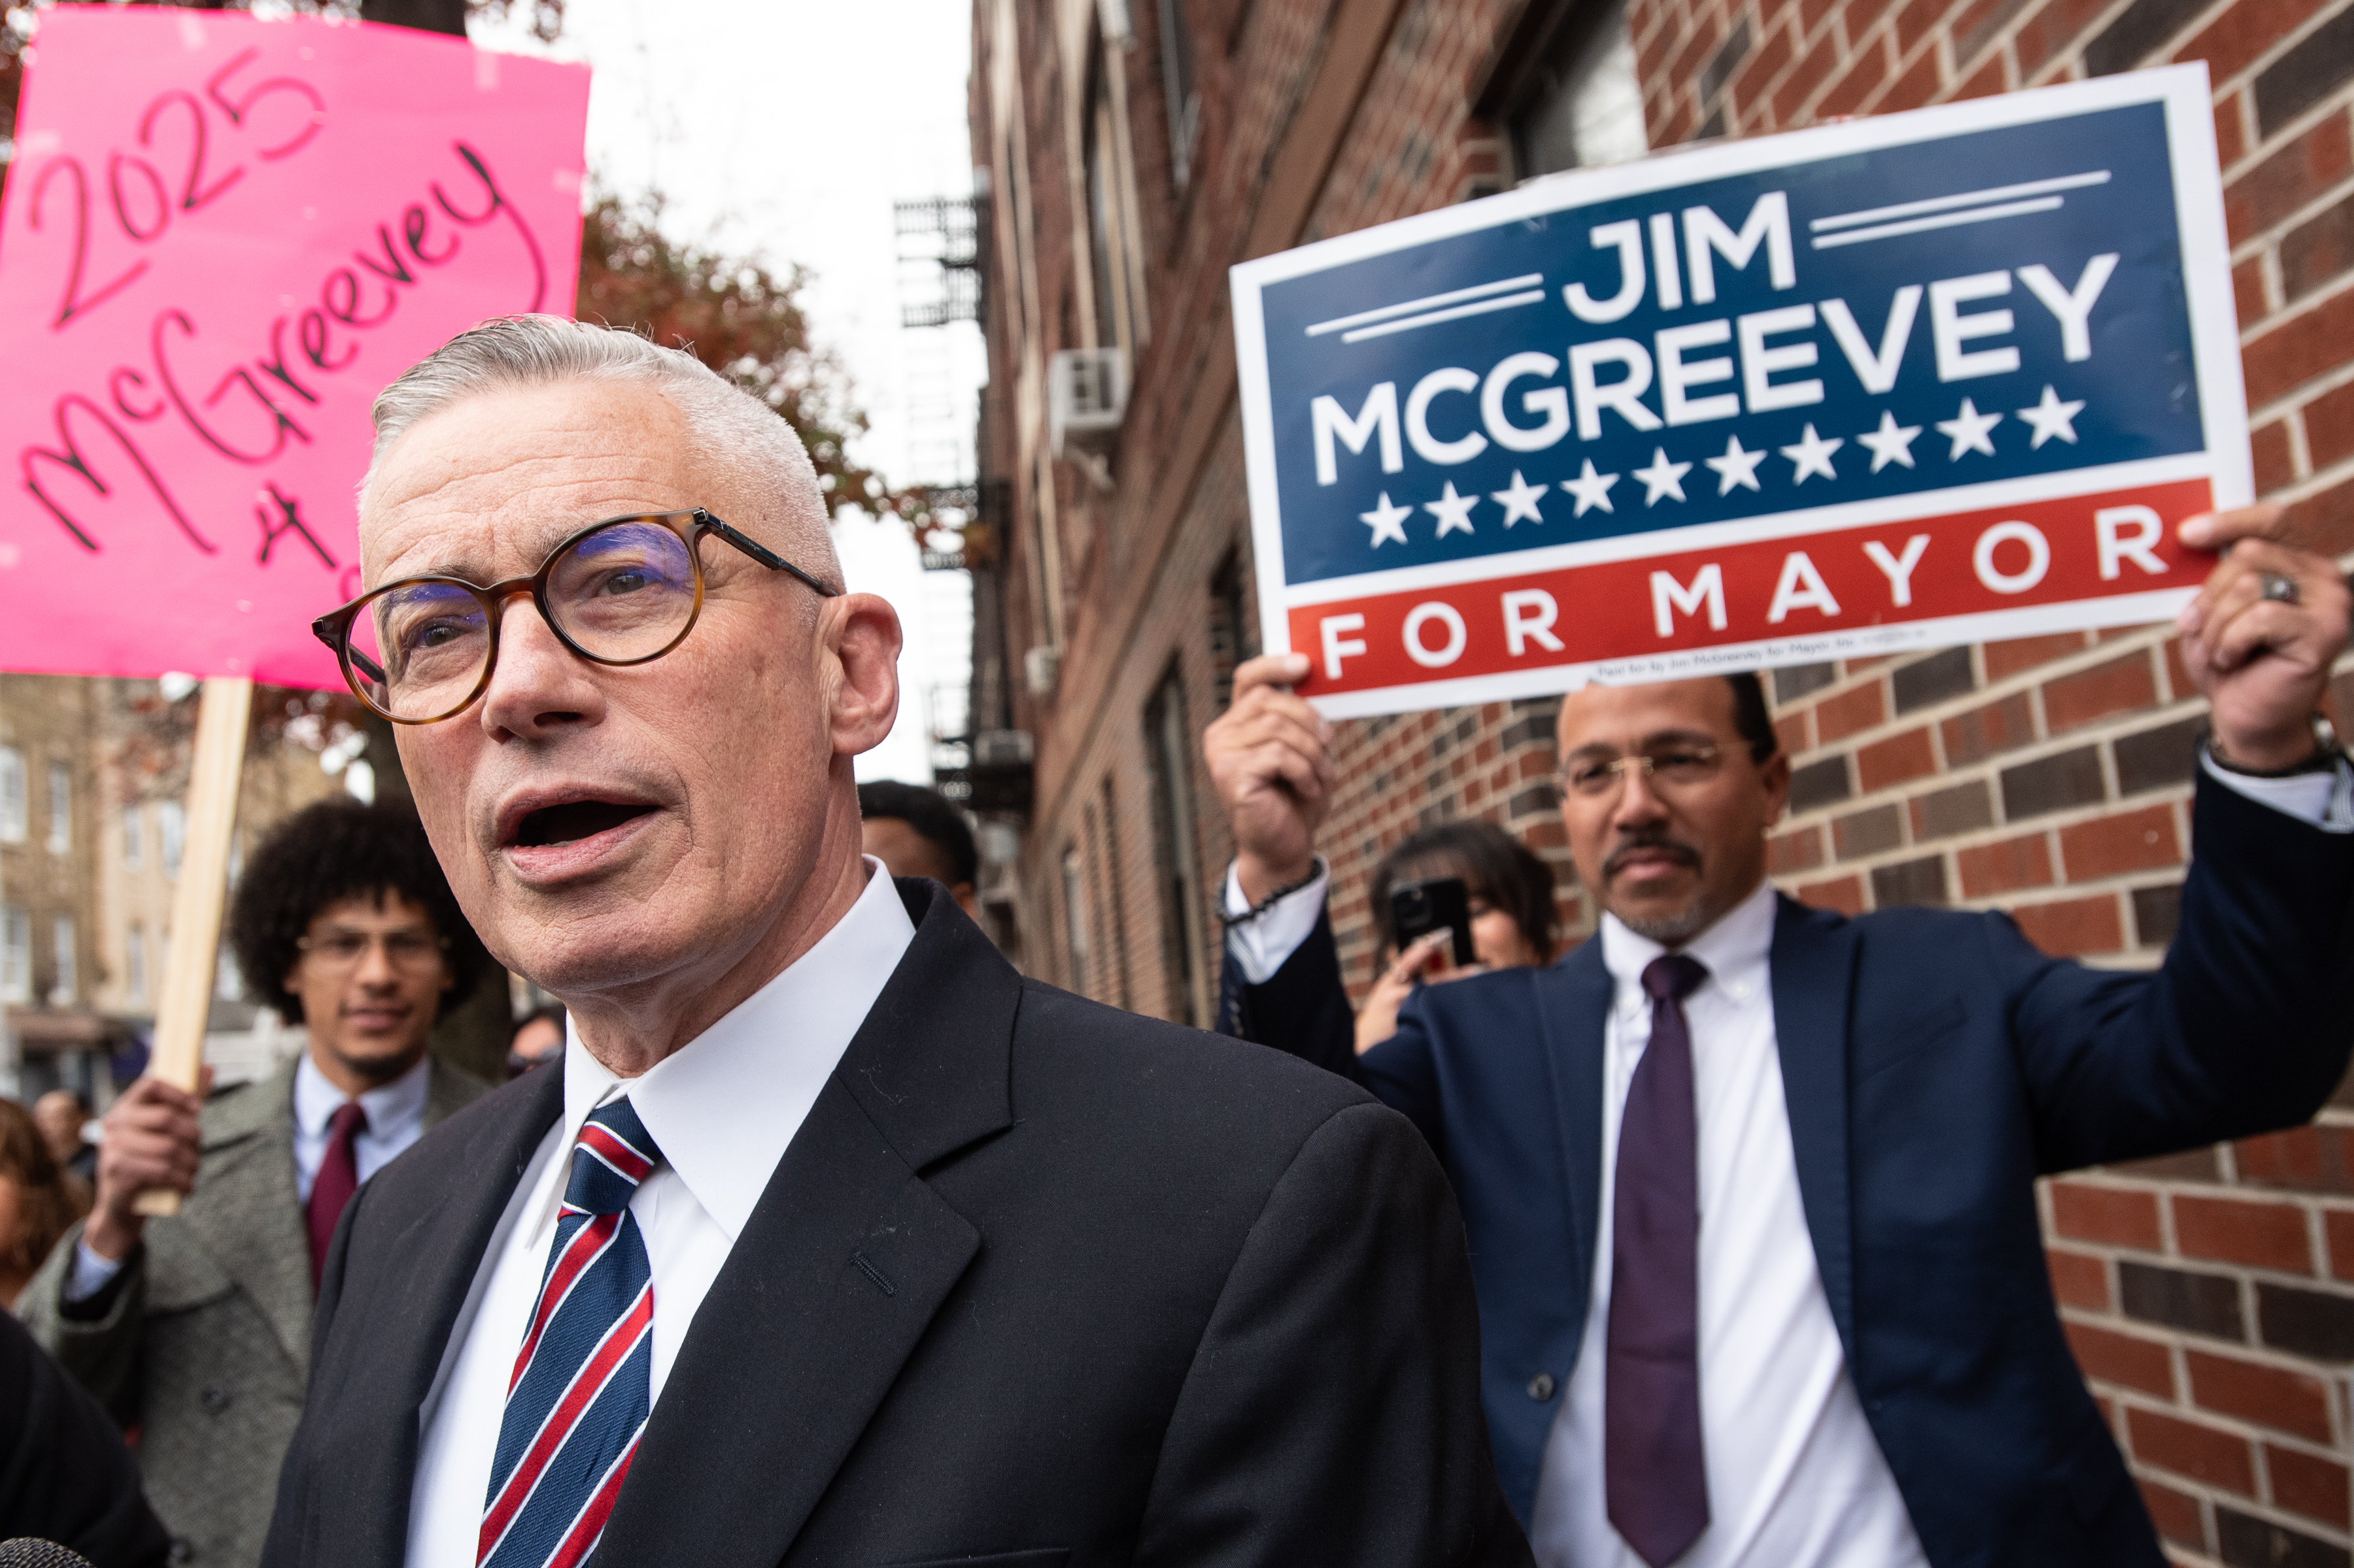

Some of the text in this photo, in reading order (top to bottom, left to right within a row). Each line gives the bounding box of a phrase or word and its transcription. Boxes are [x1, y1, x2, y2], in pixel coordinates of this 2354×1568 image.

[29, 46, 327, 330] 2025
[1563, 190, 1797, 323] JIM
[22, 141, 547, 554] McGreevey
[1310, 252, 2120, 486] MCGREEVEY
[256, 483, 337, 569] 4
[1319, 504, 2168, 680] FOR MAYOR
